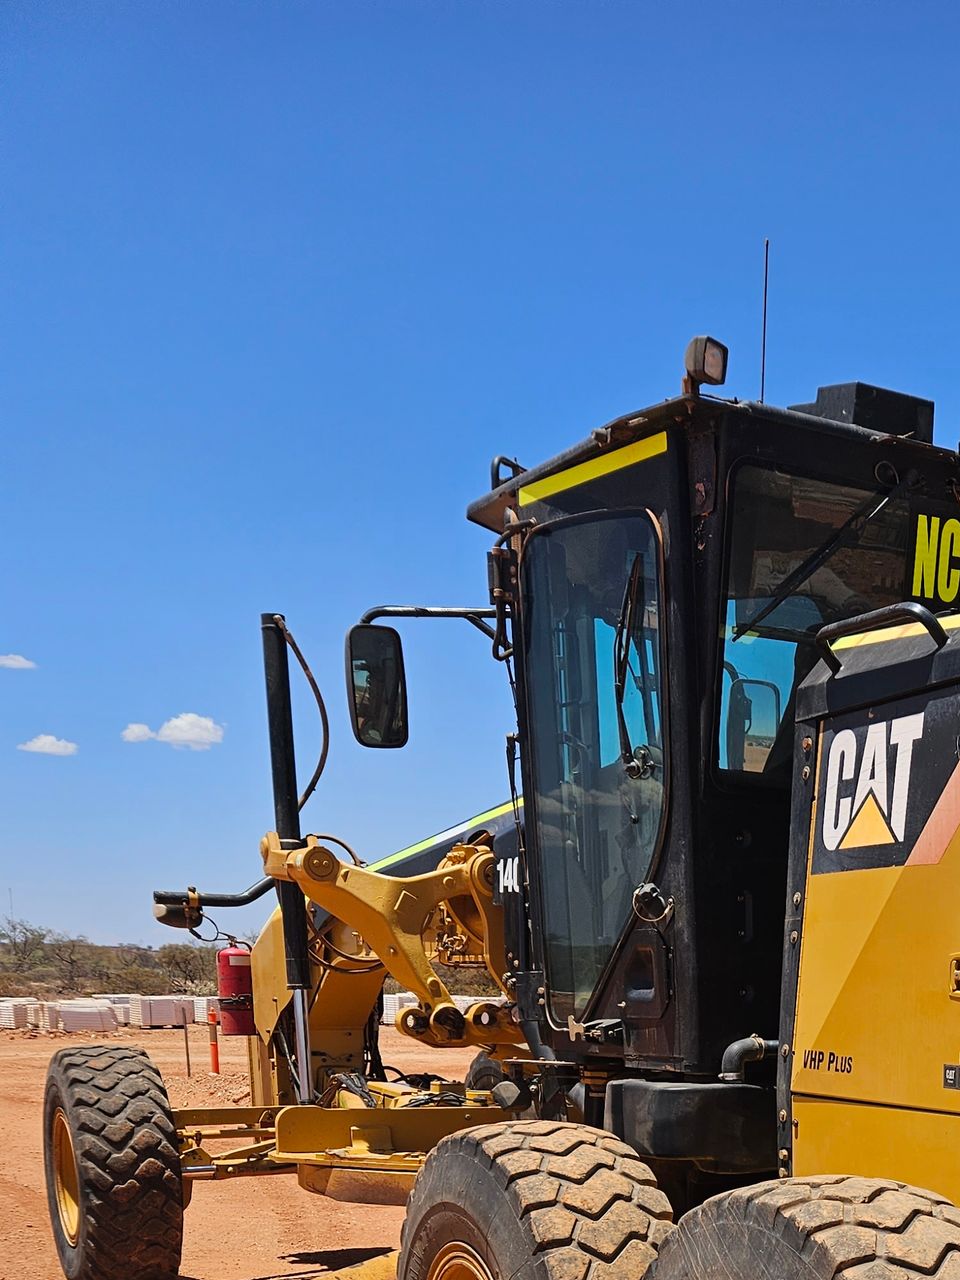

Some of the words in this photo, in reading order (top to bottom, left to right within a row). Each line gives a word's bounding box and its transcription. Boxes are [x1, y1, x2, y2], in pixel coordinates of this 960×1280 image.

[822, 711, 925, 851] CAT
[802, 1049, 825, 1071] VHP
[945, 1069, 956, 1080] CAT
